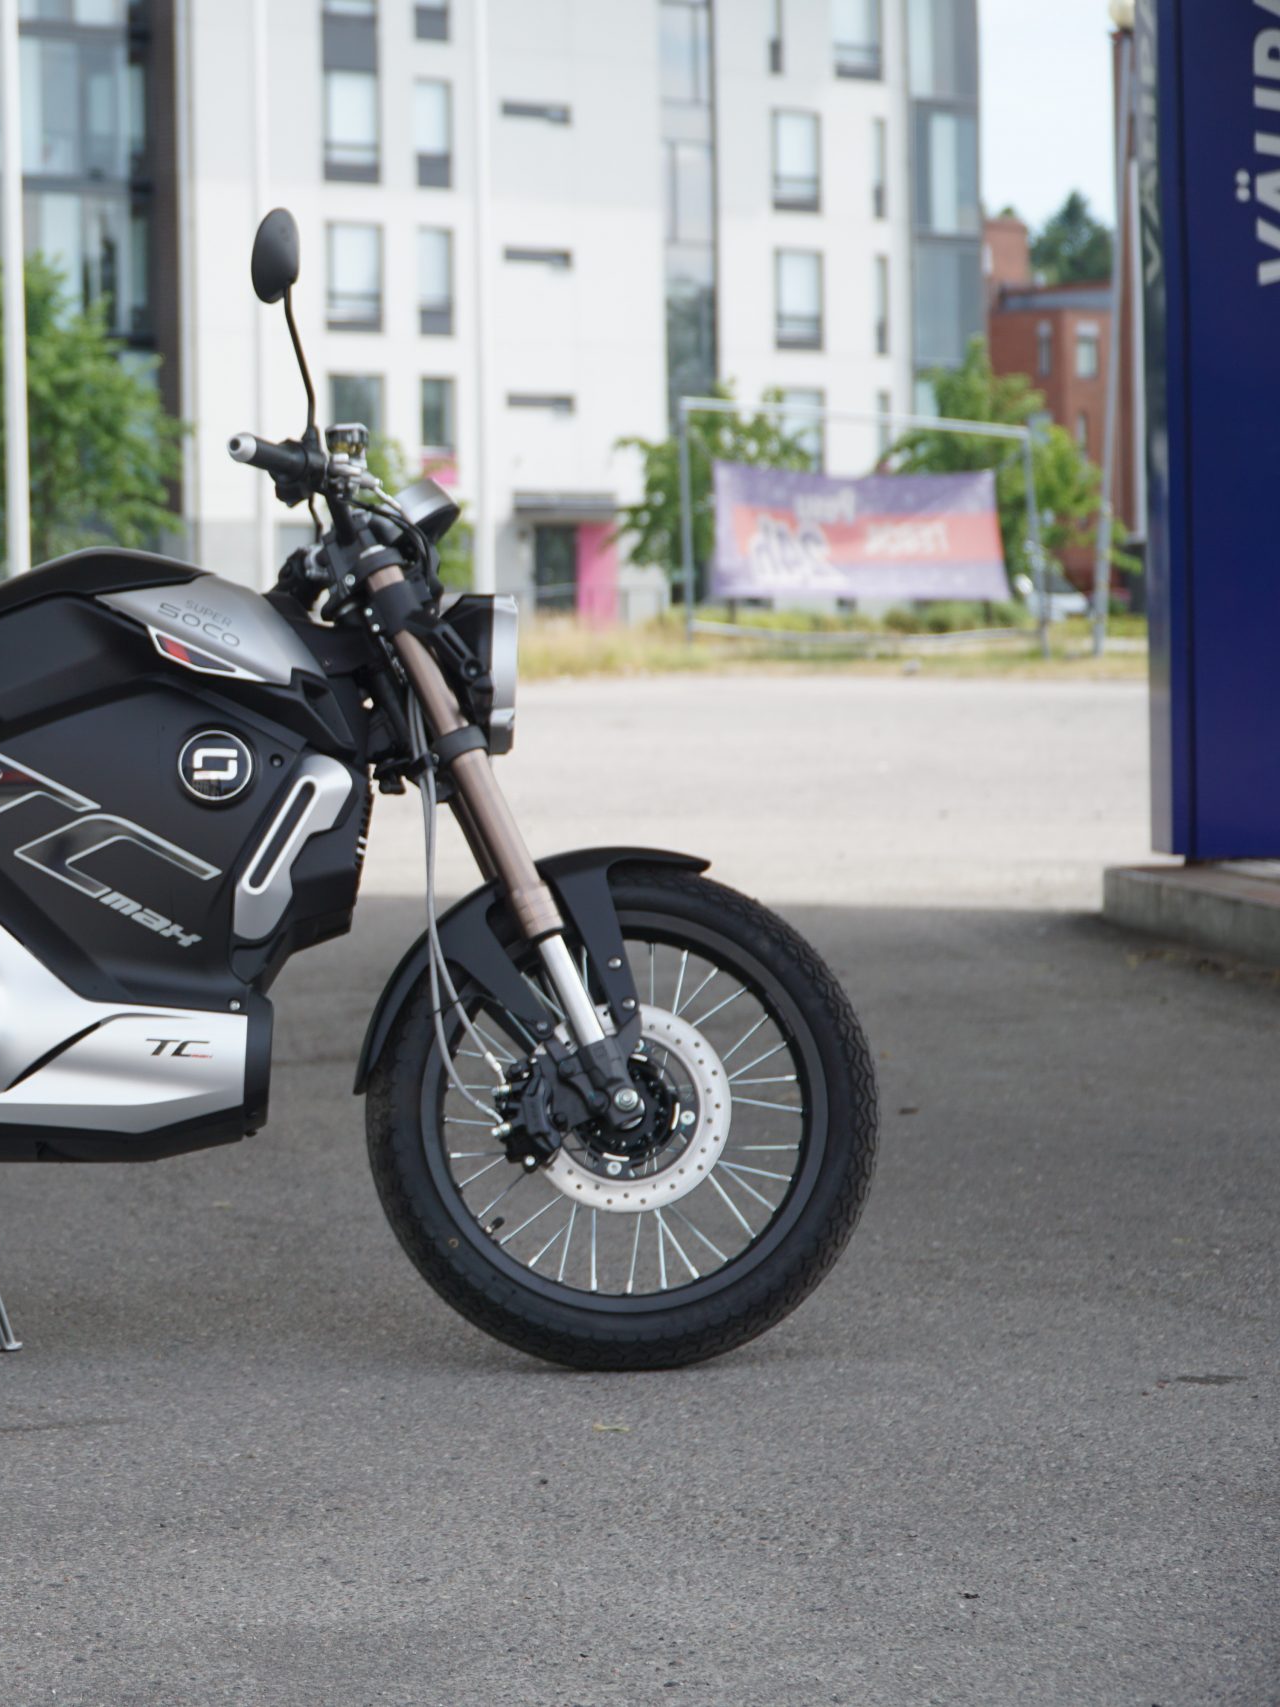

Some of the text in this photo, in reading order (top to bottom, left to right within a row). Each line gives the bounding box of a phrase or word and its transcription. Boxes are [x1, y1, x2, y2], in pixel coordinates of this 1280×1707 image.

[157, 602, 240, 647] SOCO
[185, 600, 233, 628] SUPER
[145, 1037, 211, 1058] TC
